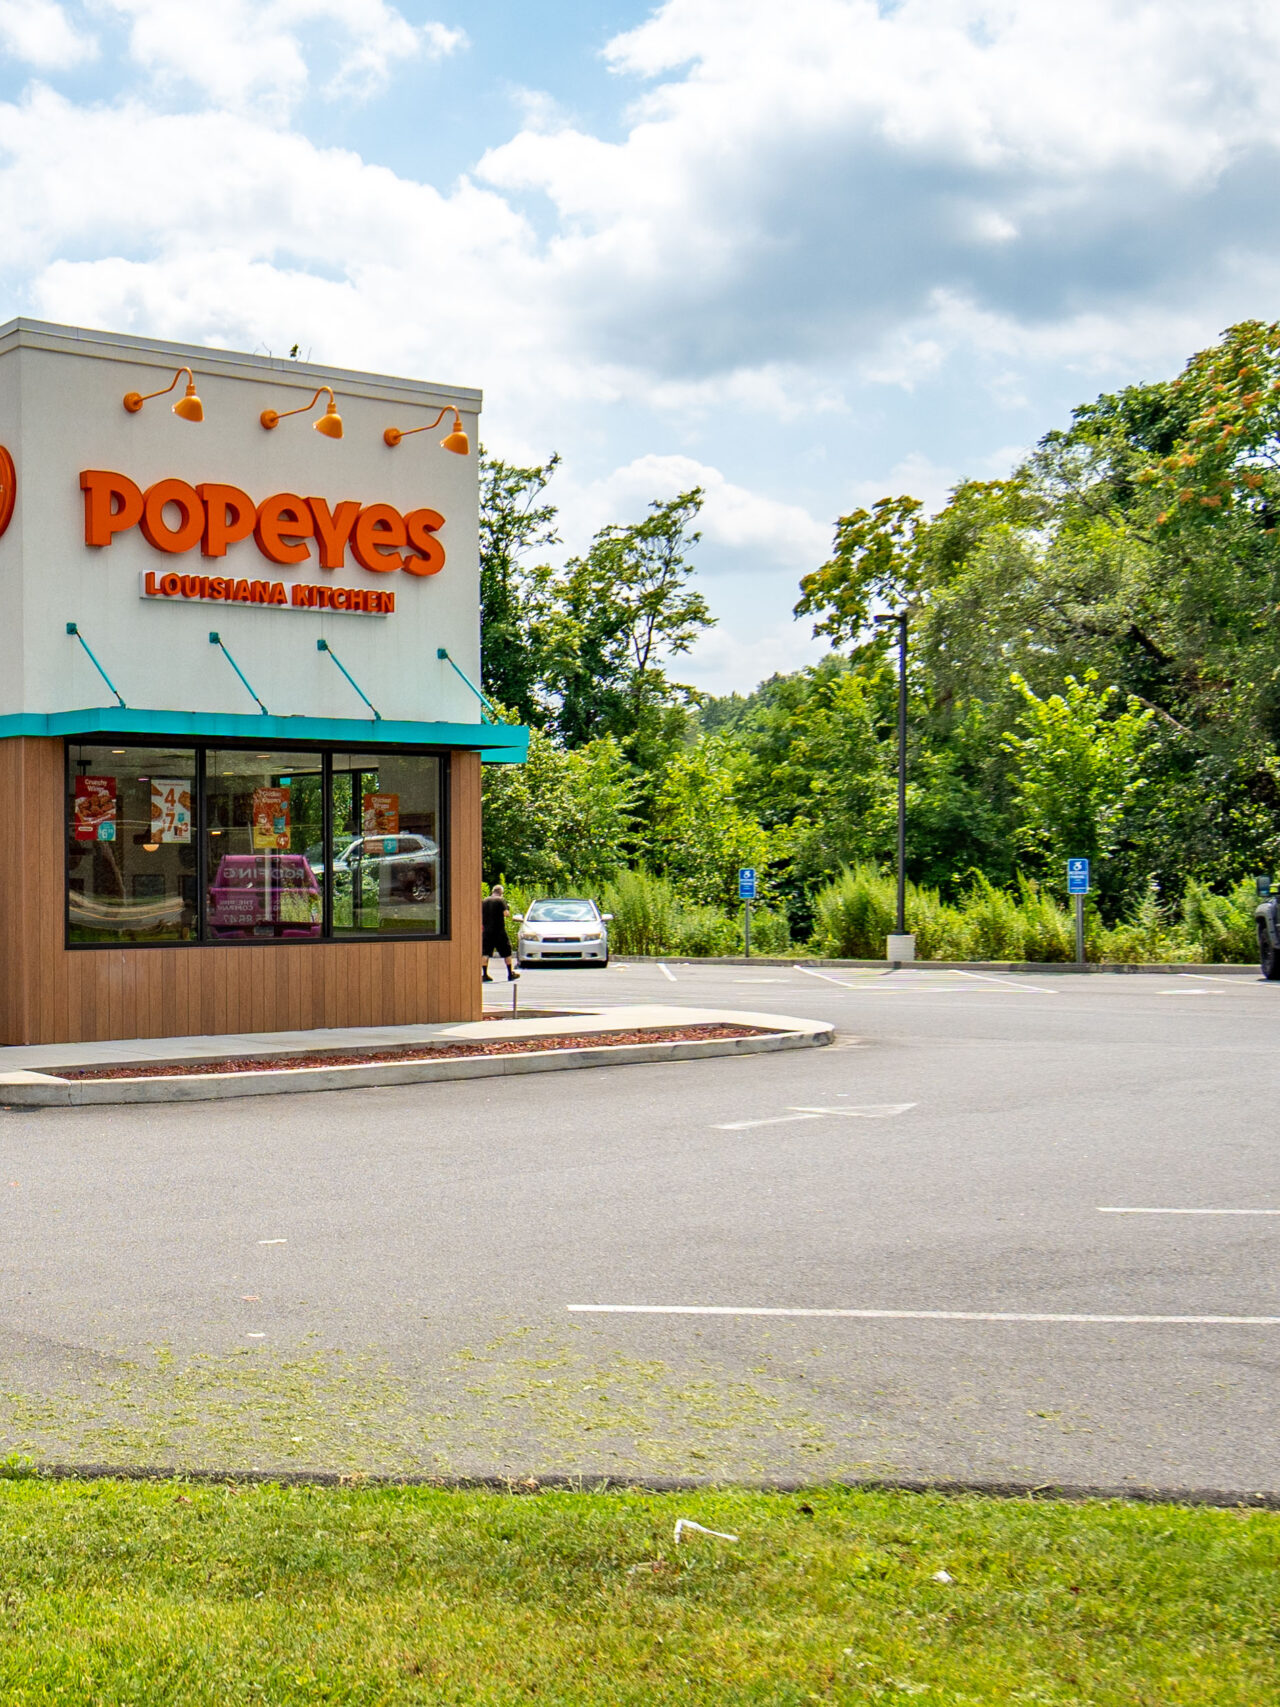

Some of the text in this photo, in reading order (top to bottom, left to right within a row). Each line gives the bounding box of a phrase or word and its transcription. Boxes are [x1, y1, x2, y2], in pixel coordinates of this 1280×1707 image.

[145, 571, 395, 613] LOUISIANA KITCHEN
[164, 788, 176, 807] 4
